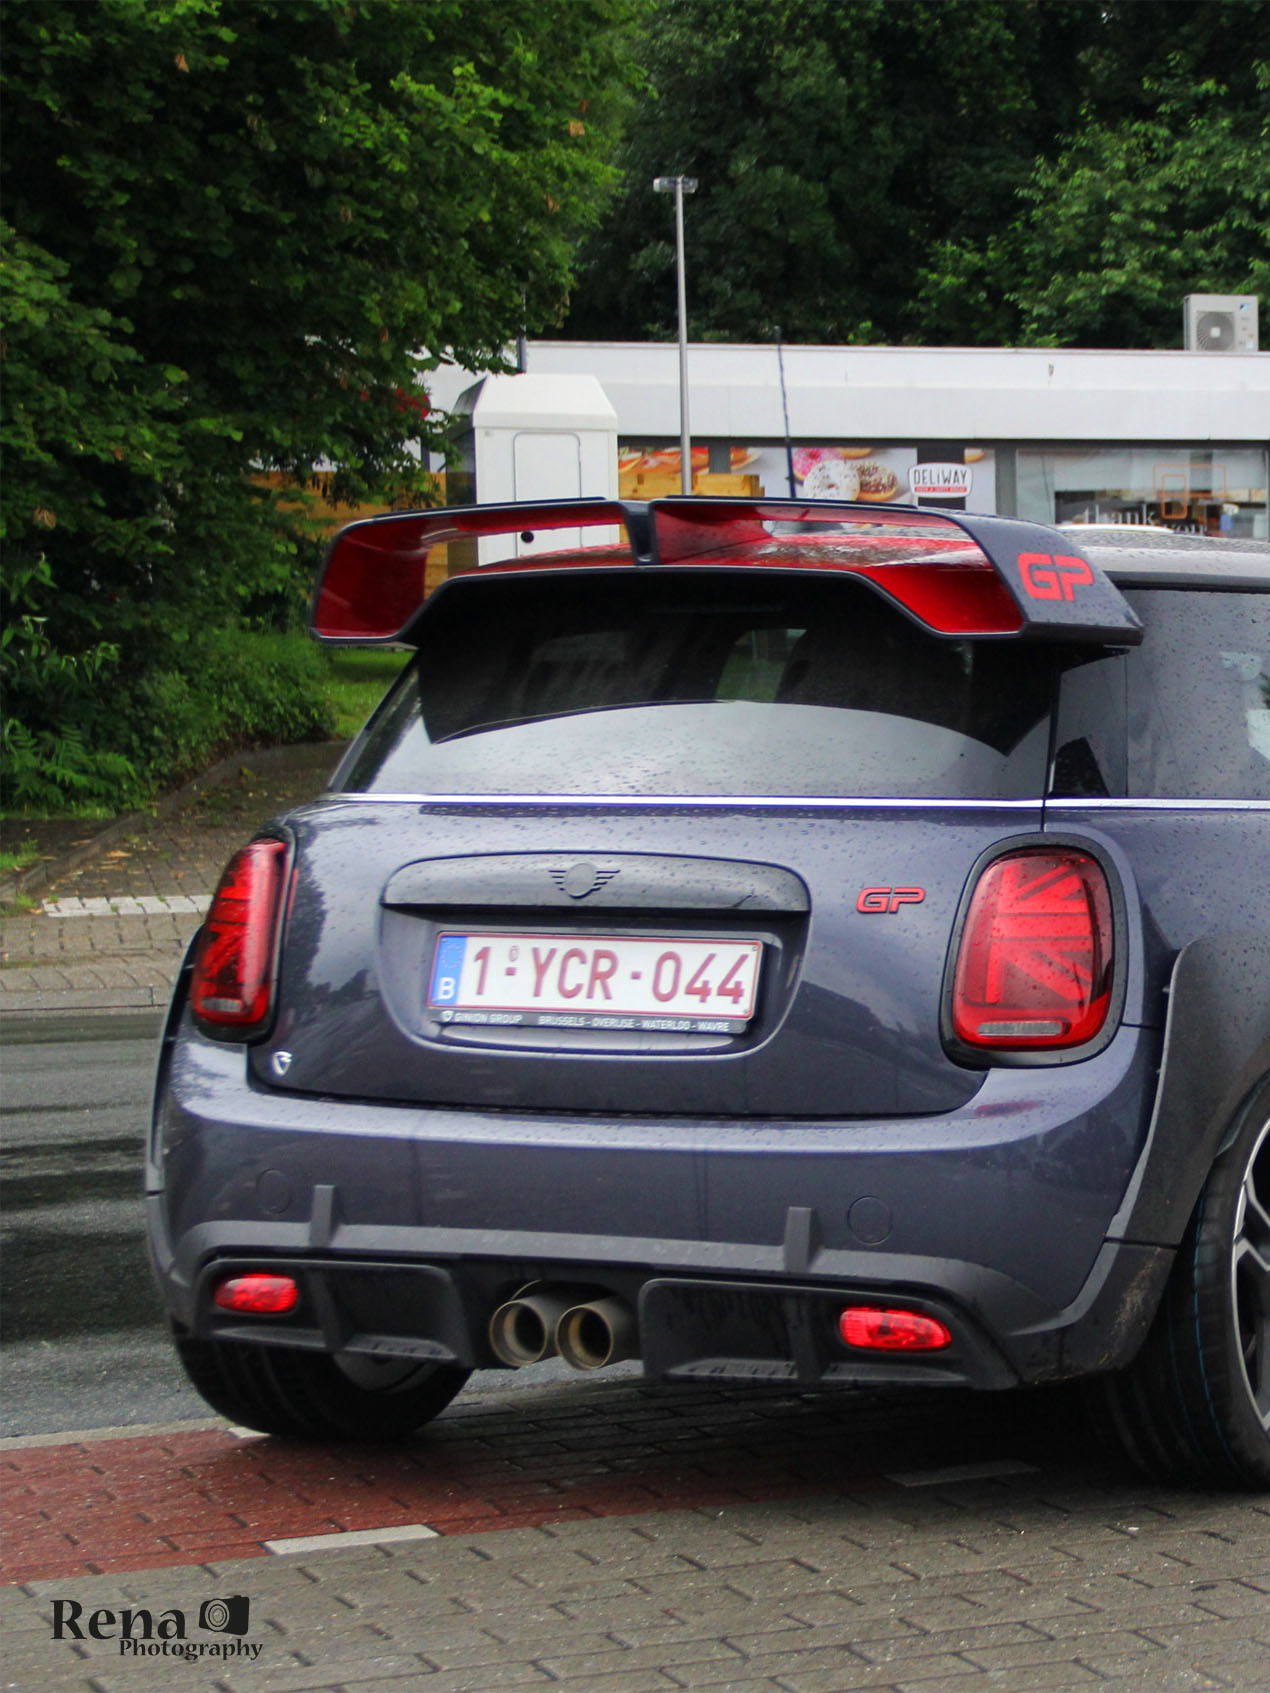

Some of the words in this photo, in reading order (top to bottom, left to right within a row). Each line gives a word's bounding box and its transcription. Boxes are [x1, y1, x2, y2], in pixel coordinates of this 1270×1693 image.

[1017, 552, 1095, 602] GP
[856, 887, 926, 914] GP
[437, 976, 455, 1001] B
[488, 1013, 523, 1025] GROUP
[538, 1015, 586, 1026] BRUSSELS
[641, 1019, 691, 1031] WATERLOO
[697, 1021, 730, 1032] WAVRE
